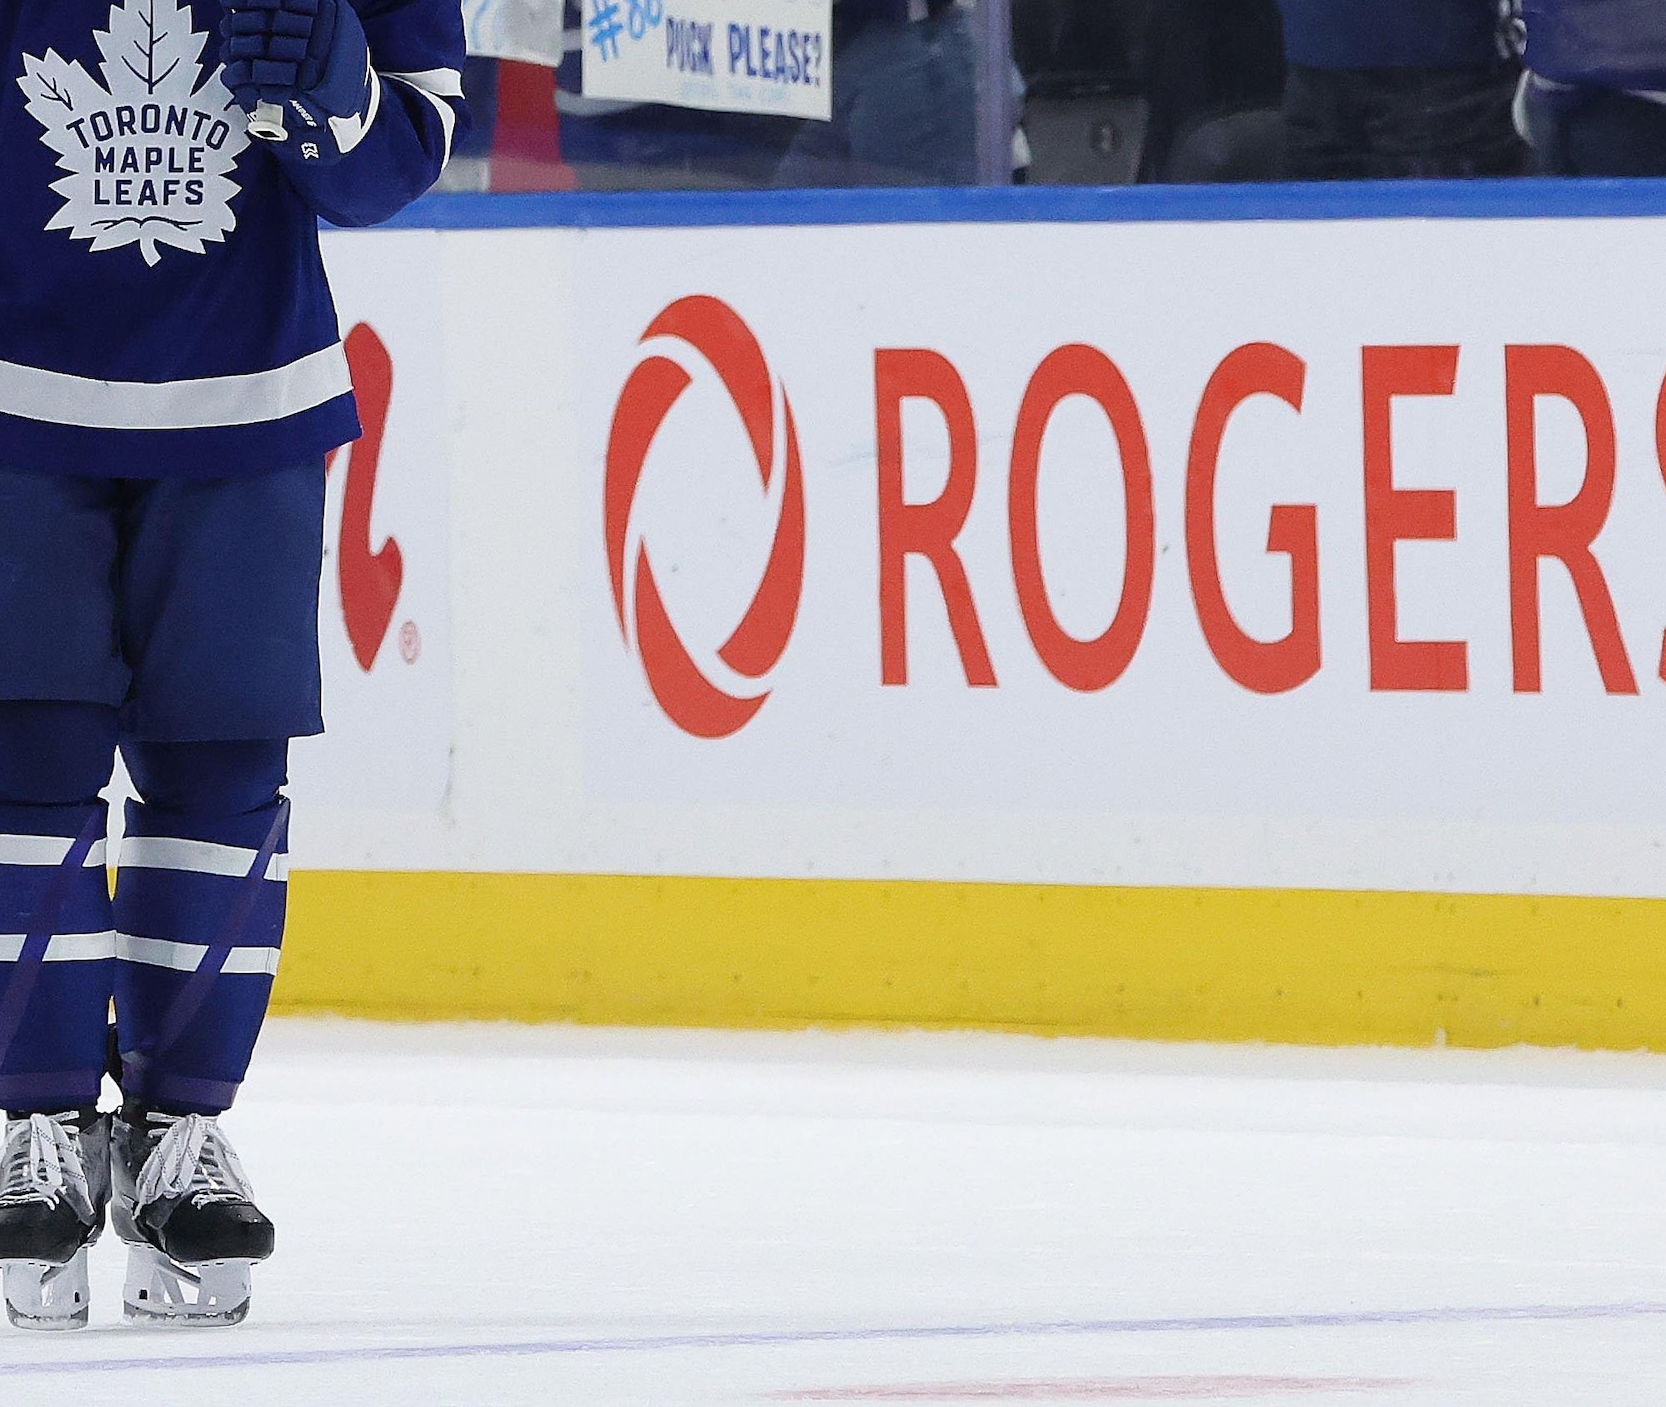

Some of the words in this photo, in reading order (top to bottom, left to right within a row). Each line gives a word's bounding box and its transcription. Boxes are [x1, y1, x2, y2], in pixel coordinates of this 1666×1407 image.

[728, 21, 822, 88] PLEASE?
[66, 104, 230, 151] TORONTO
[94, 147, 205, 174] MAPLE
[94, 179, 204, 206] LEAFS
